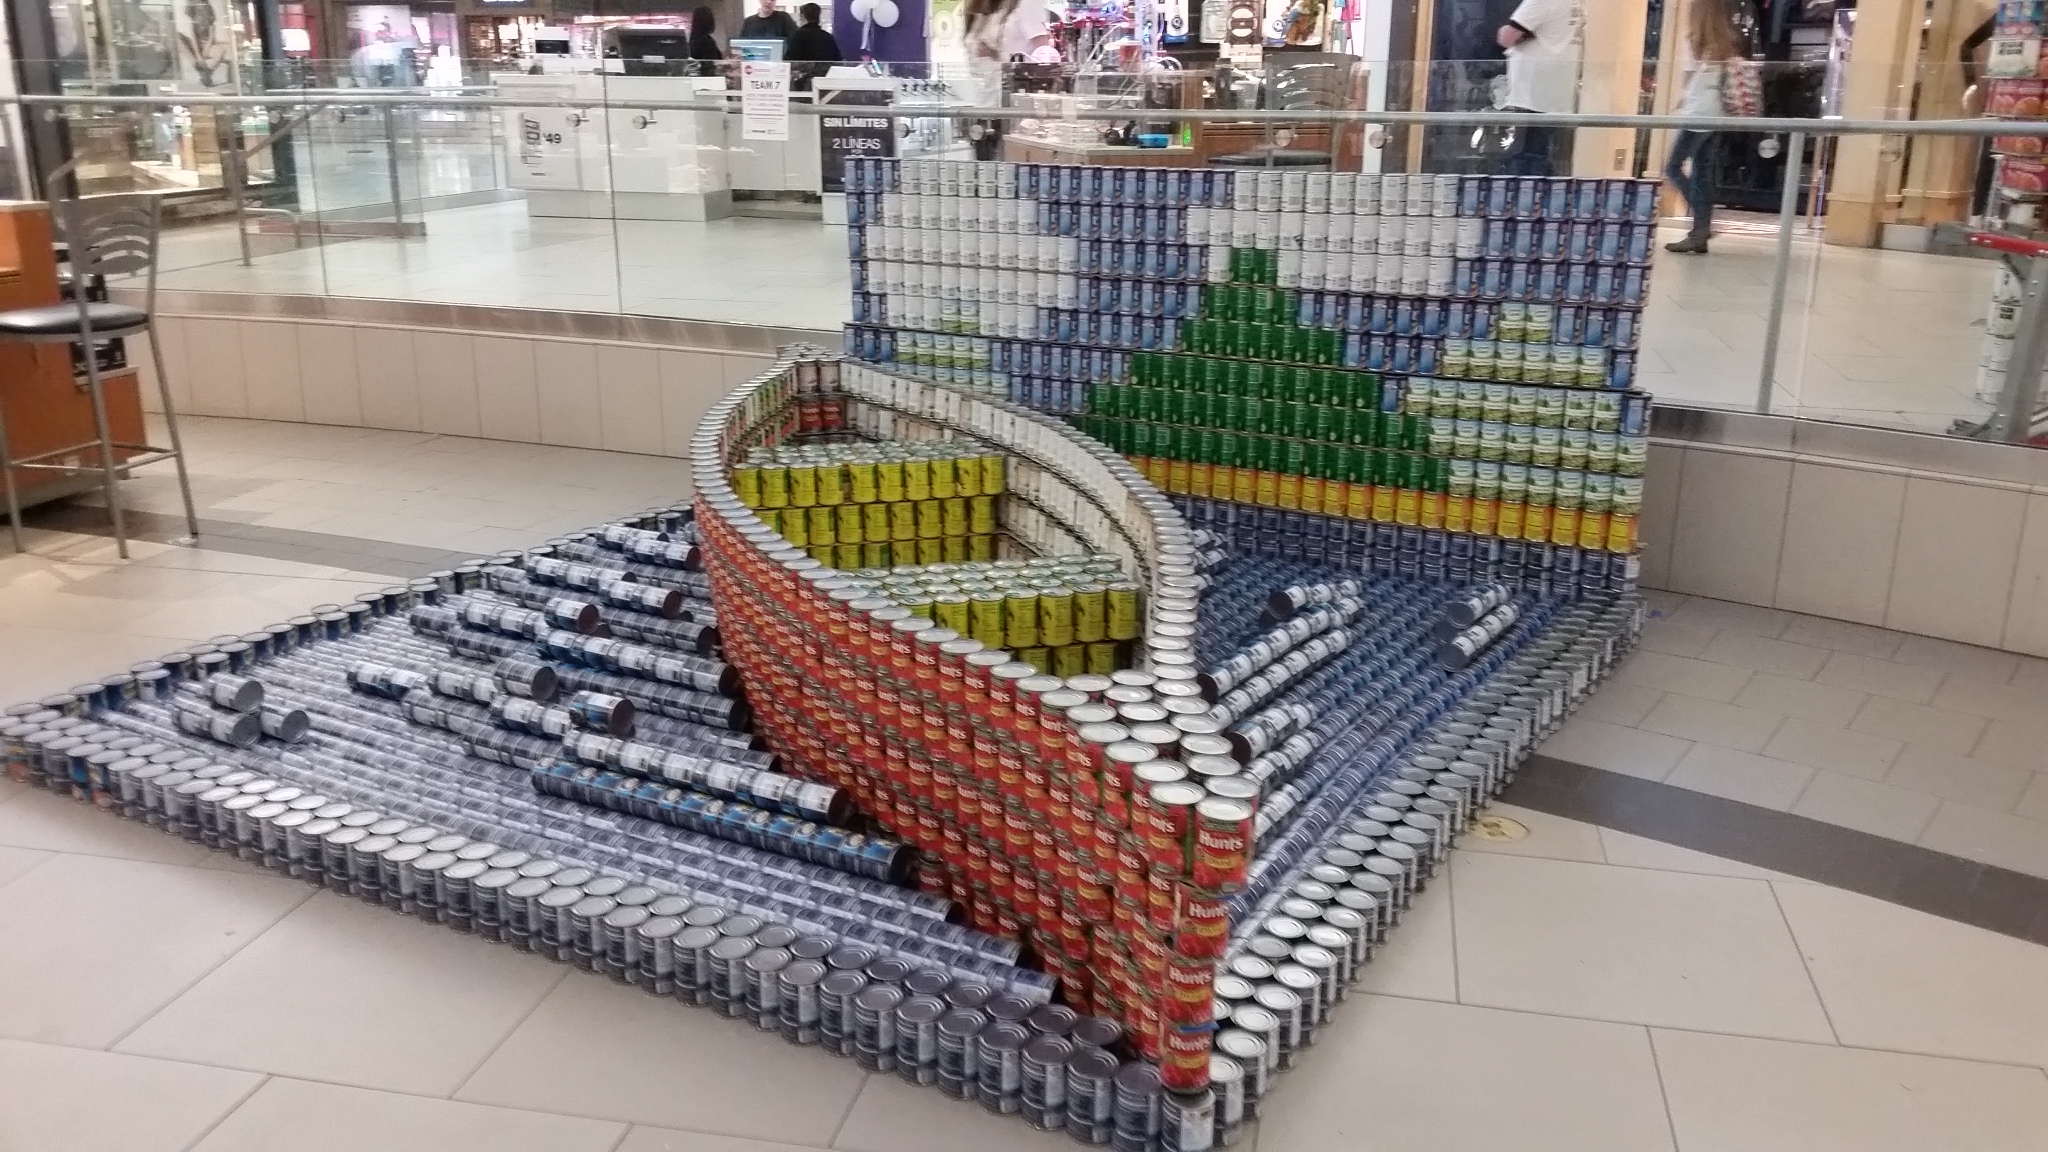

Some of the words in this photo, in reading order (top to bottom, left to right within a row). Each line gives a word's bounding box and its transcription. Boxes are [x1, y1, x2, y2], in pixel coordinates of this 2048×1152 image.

[750, 81, 773, 89] TEAM
[775, 81, 781, 89] 7
[823, 117, 842, 128] SIN
[843, 115, 888, 128] LÍMITES
[832, 138, 840, 149] 2
[842, 136, 881, 149] LÍNEAS
